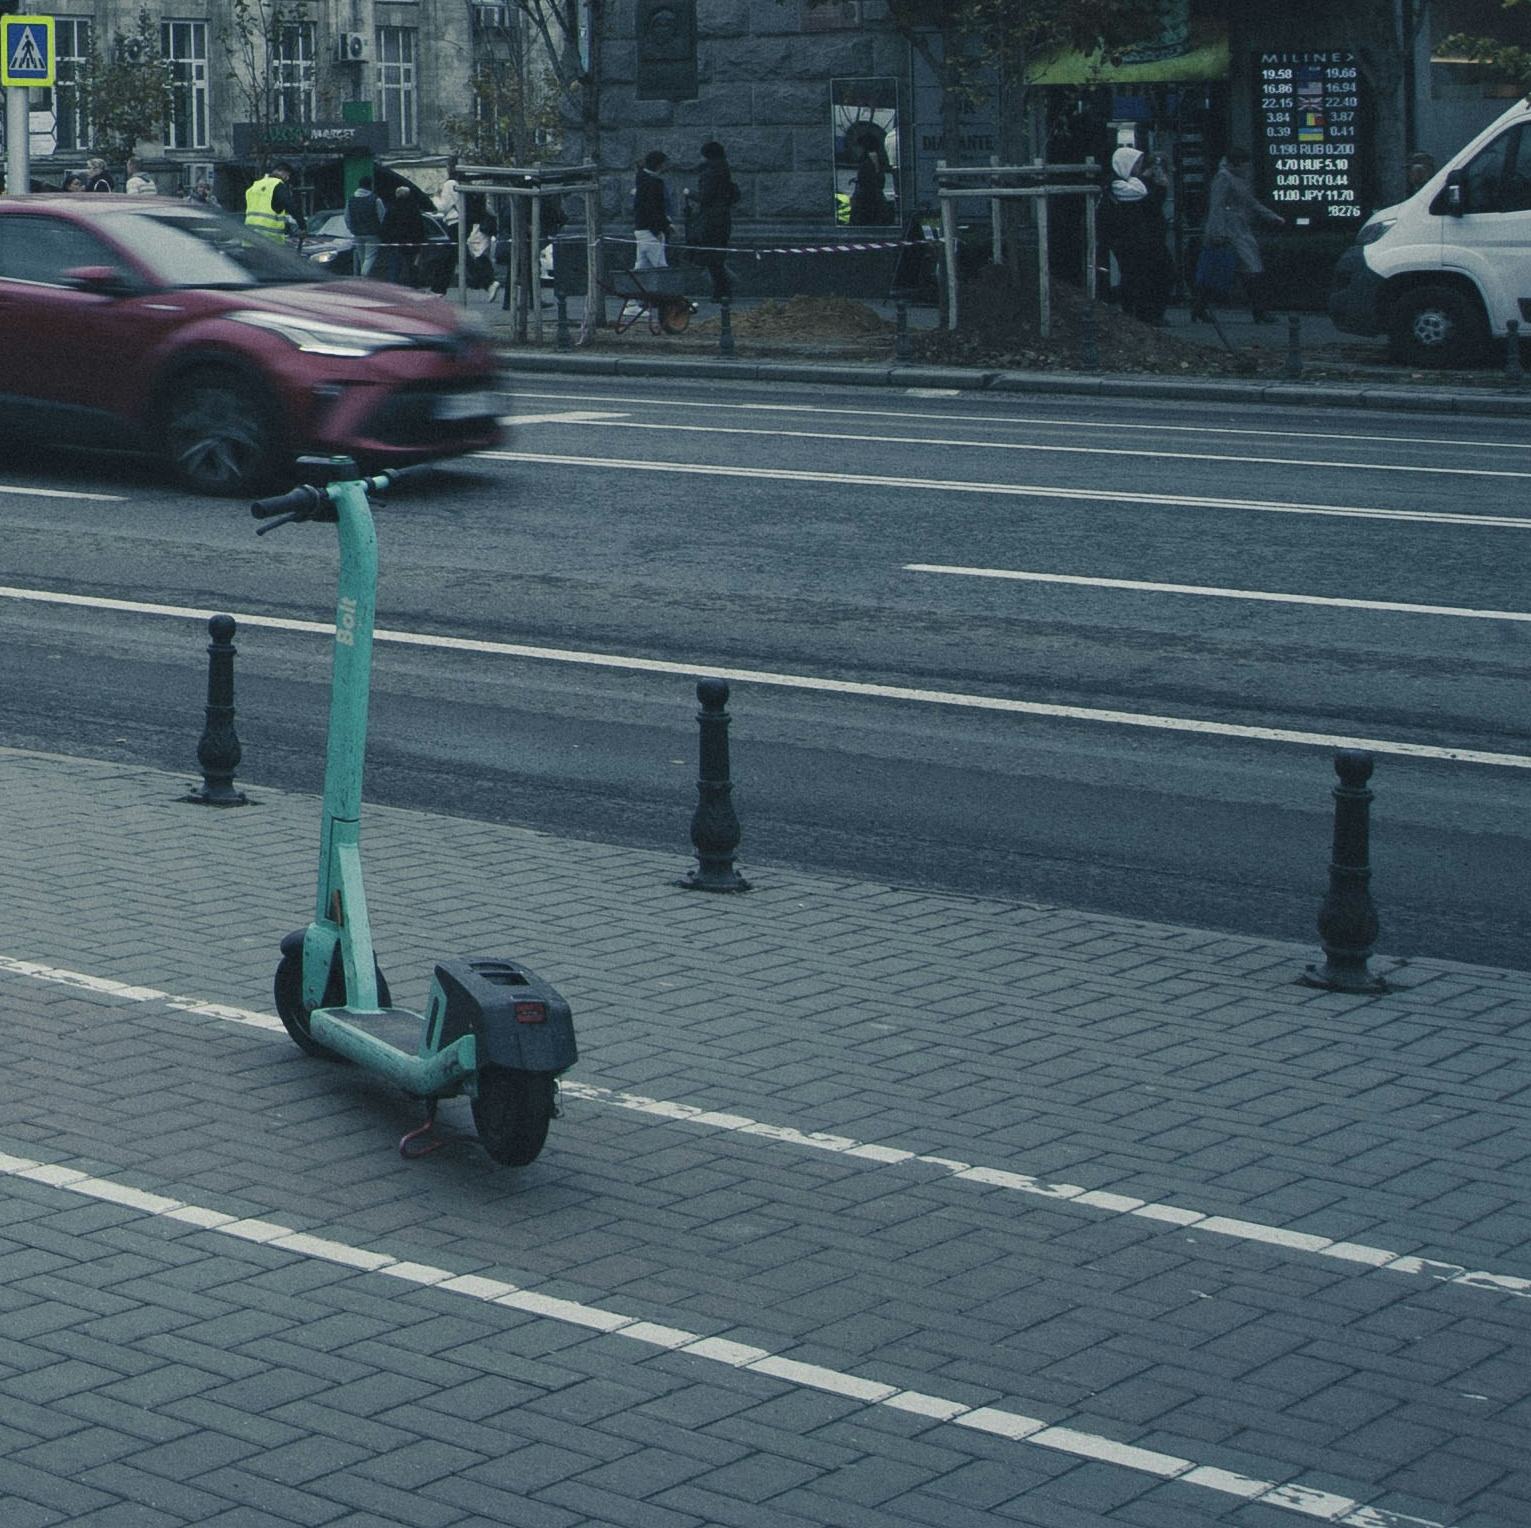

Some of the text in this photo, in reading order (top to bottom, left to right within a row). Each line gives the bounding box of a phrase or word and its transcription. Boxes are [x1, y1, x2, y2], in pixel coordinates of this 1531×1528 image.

[1261, 53, 1340, 63] MILINE
[1262, 68, 1357, 79] 19.58 19.66
[1326, 83, 1356, 92] 16.94
[1262, 97, 1357, 108] 22.15 22.40
[1267, 112, 1354, 122] 3.84 3.87
[1266, 126, 1354, 136] 0.39 0.41
[922, 136, 995, 151] DIAANTE
[1299, 144, 1324, 154] RUB
[1275, 159, 1348, 170] 4.70 HUF 5.10
[1277, 174, 1348, 185] 0.40 TRY 0.44
[1272, 190, 1354, 200] 11.00 JPY 11.70
[336, 596, 357, 647] Bolt
